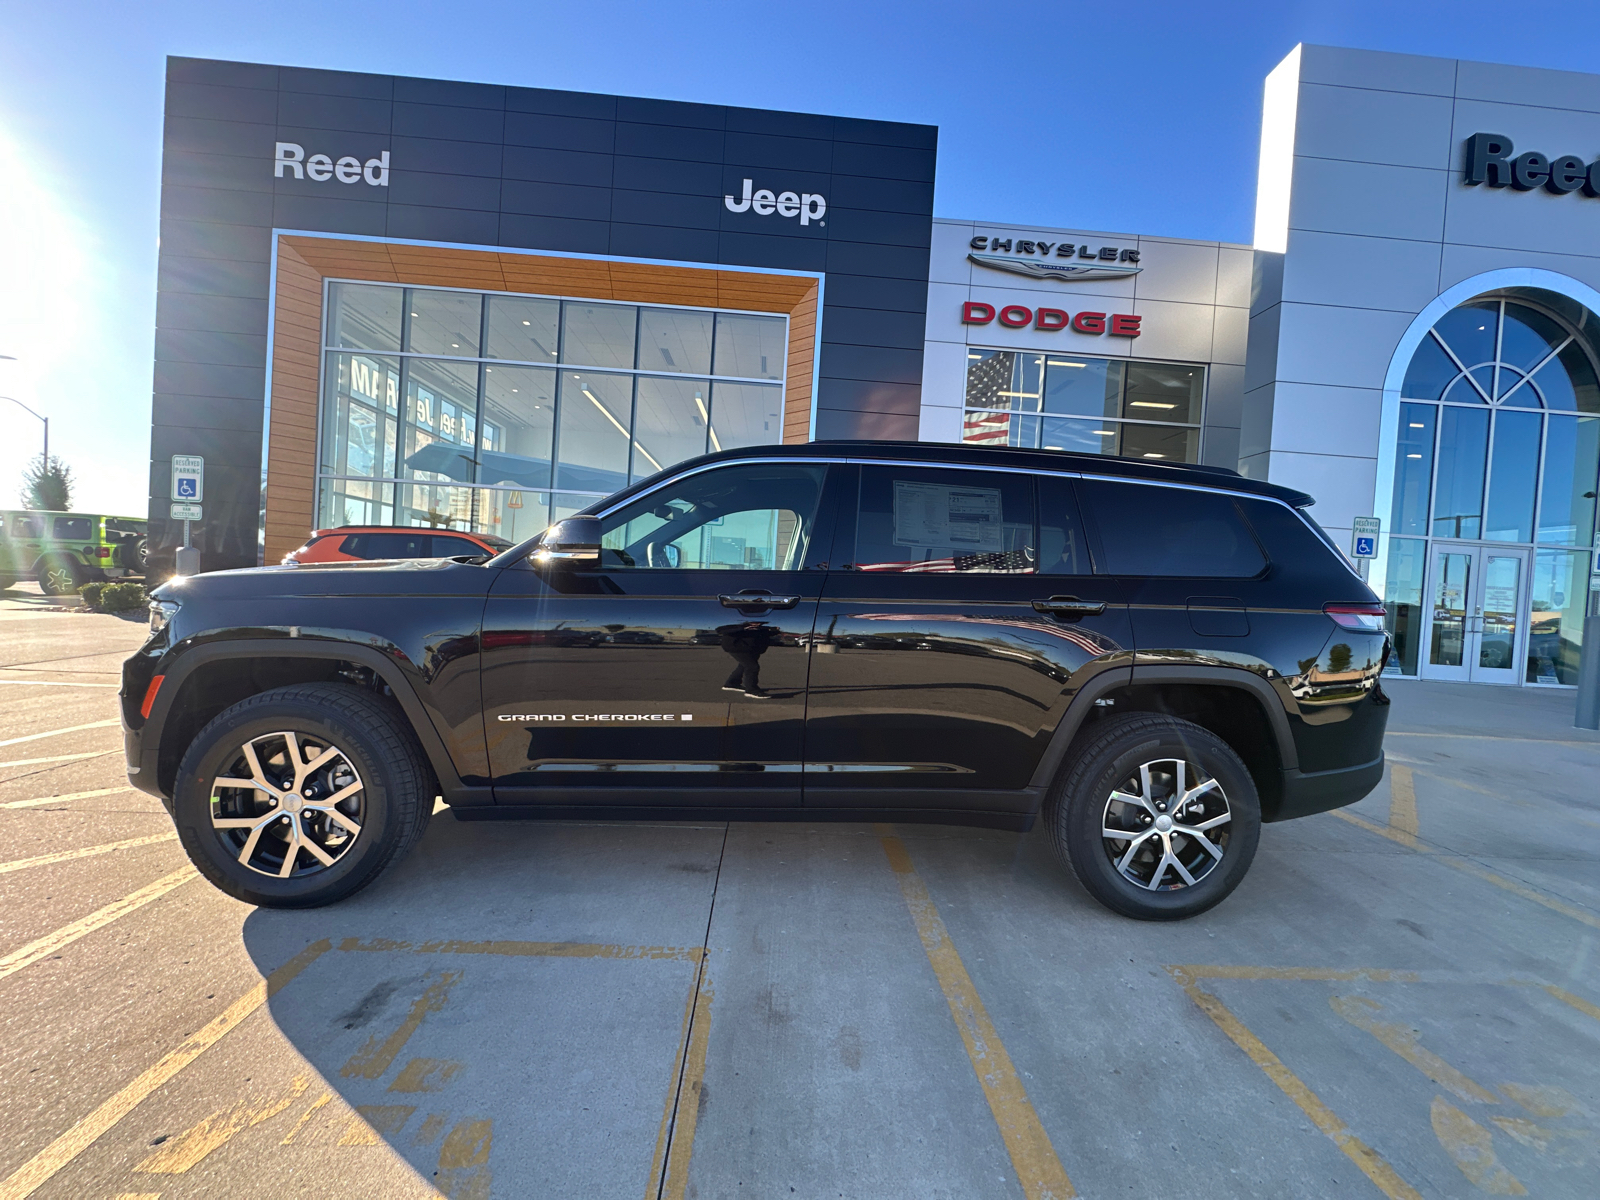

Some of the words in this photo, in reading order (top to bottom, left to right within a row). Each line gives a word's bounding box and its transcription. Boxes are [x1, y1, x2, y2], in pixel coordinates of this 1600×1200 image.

[274, 142, 391, 187] Reed
[725, 179, 827, 227] Jeep
[970, 236, 1141, 262] CHRYSLER
[962, 301, 1142, 337] DODGE
[1355, 520, 1378, 528] RESERVED
[497, 714, 566, 722] GRAND
